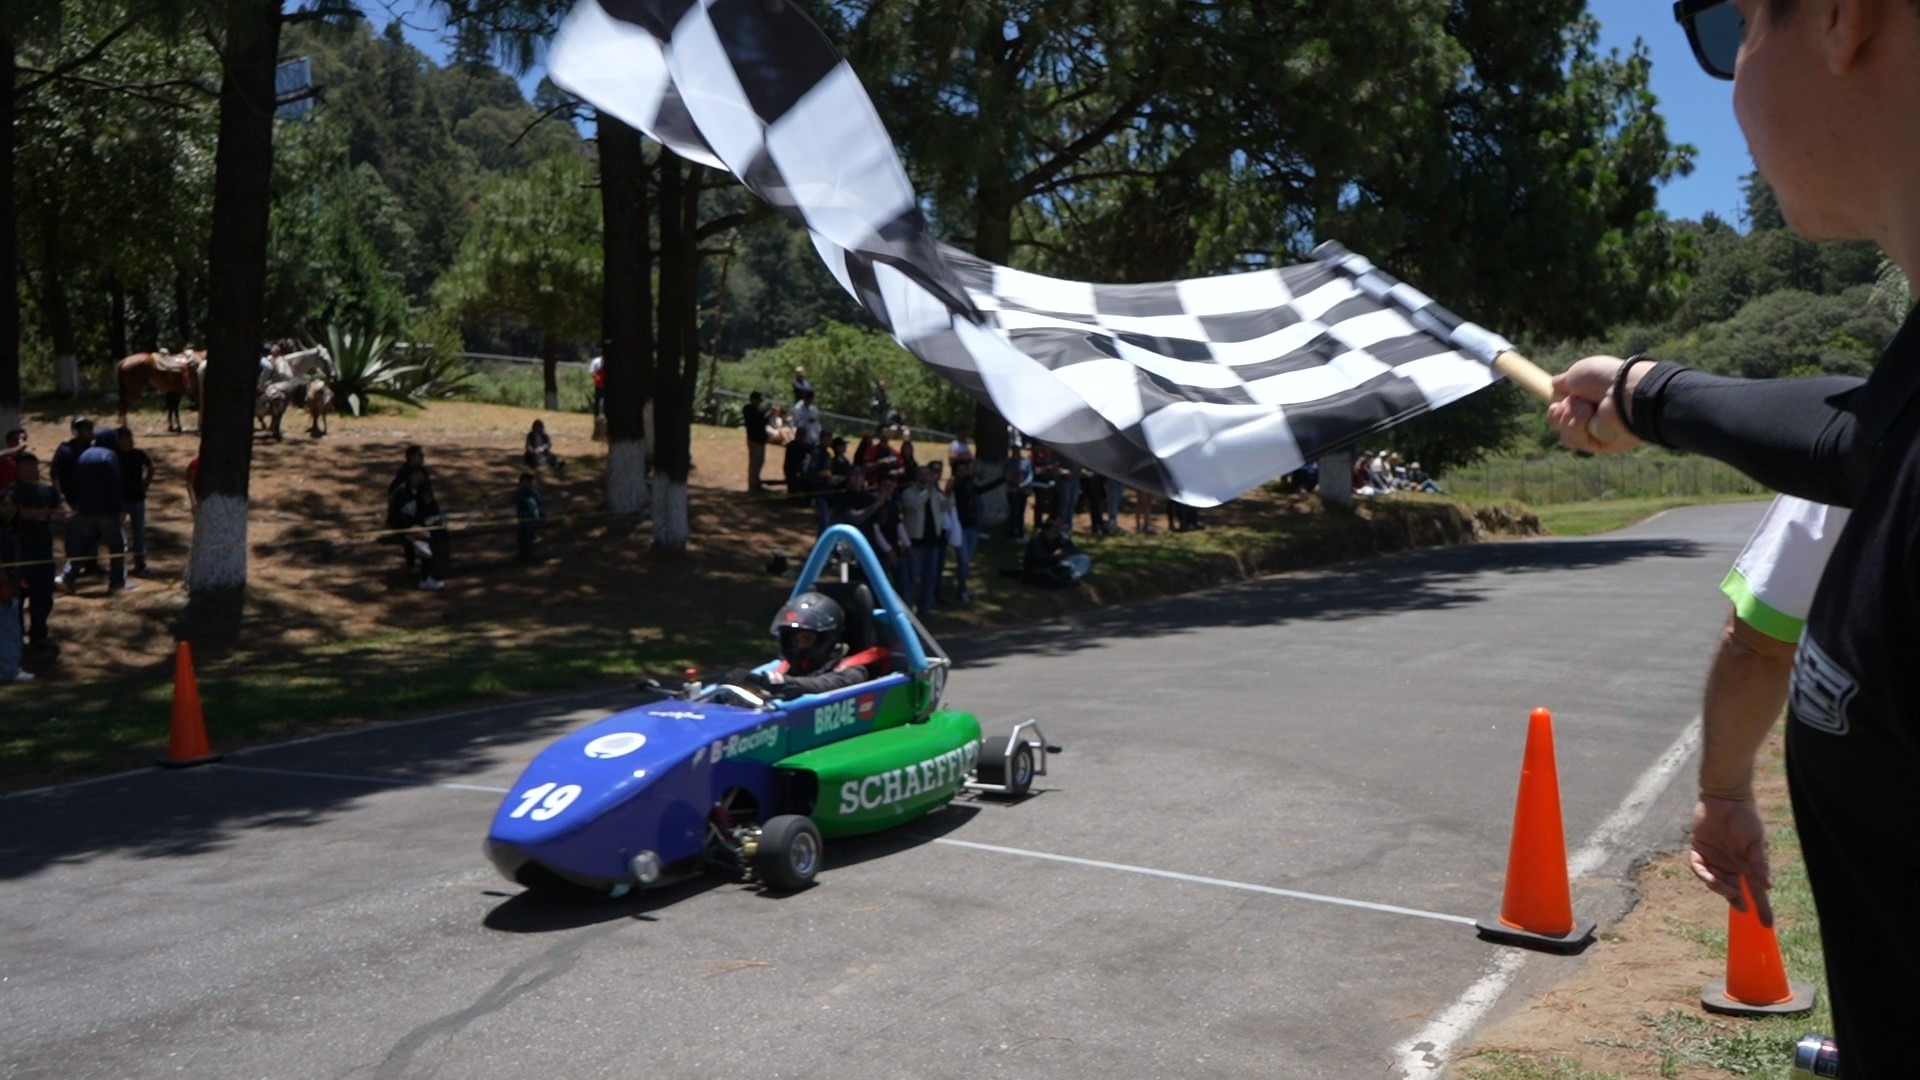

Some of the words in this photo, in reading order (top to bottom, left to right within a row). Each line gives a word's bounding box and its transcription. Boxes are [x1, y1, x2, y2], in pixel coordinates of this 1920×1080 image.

[814, 697, 857, 735] BR24E
[710, 724, 779, 764] B-Racing
[508, 782, 582, 821] 19
